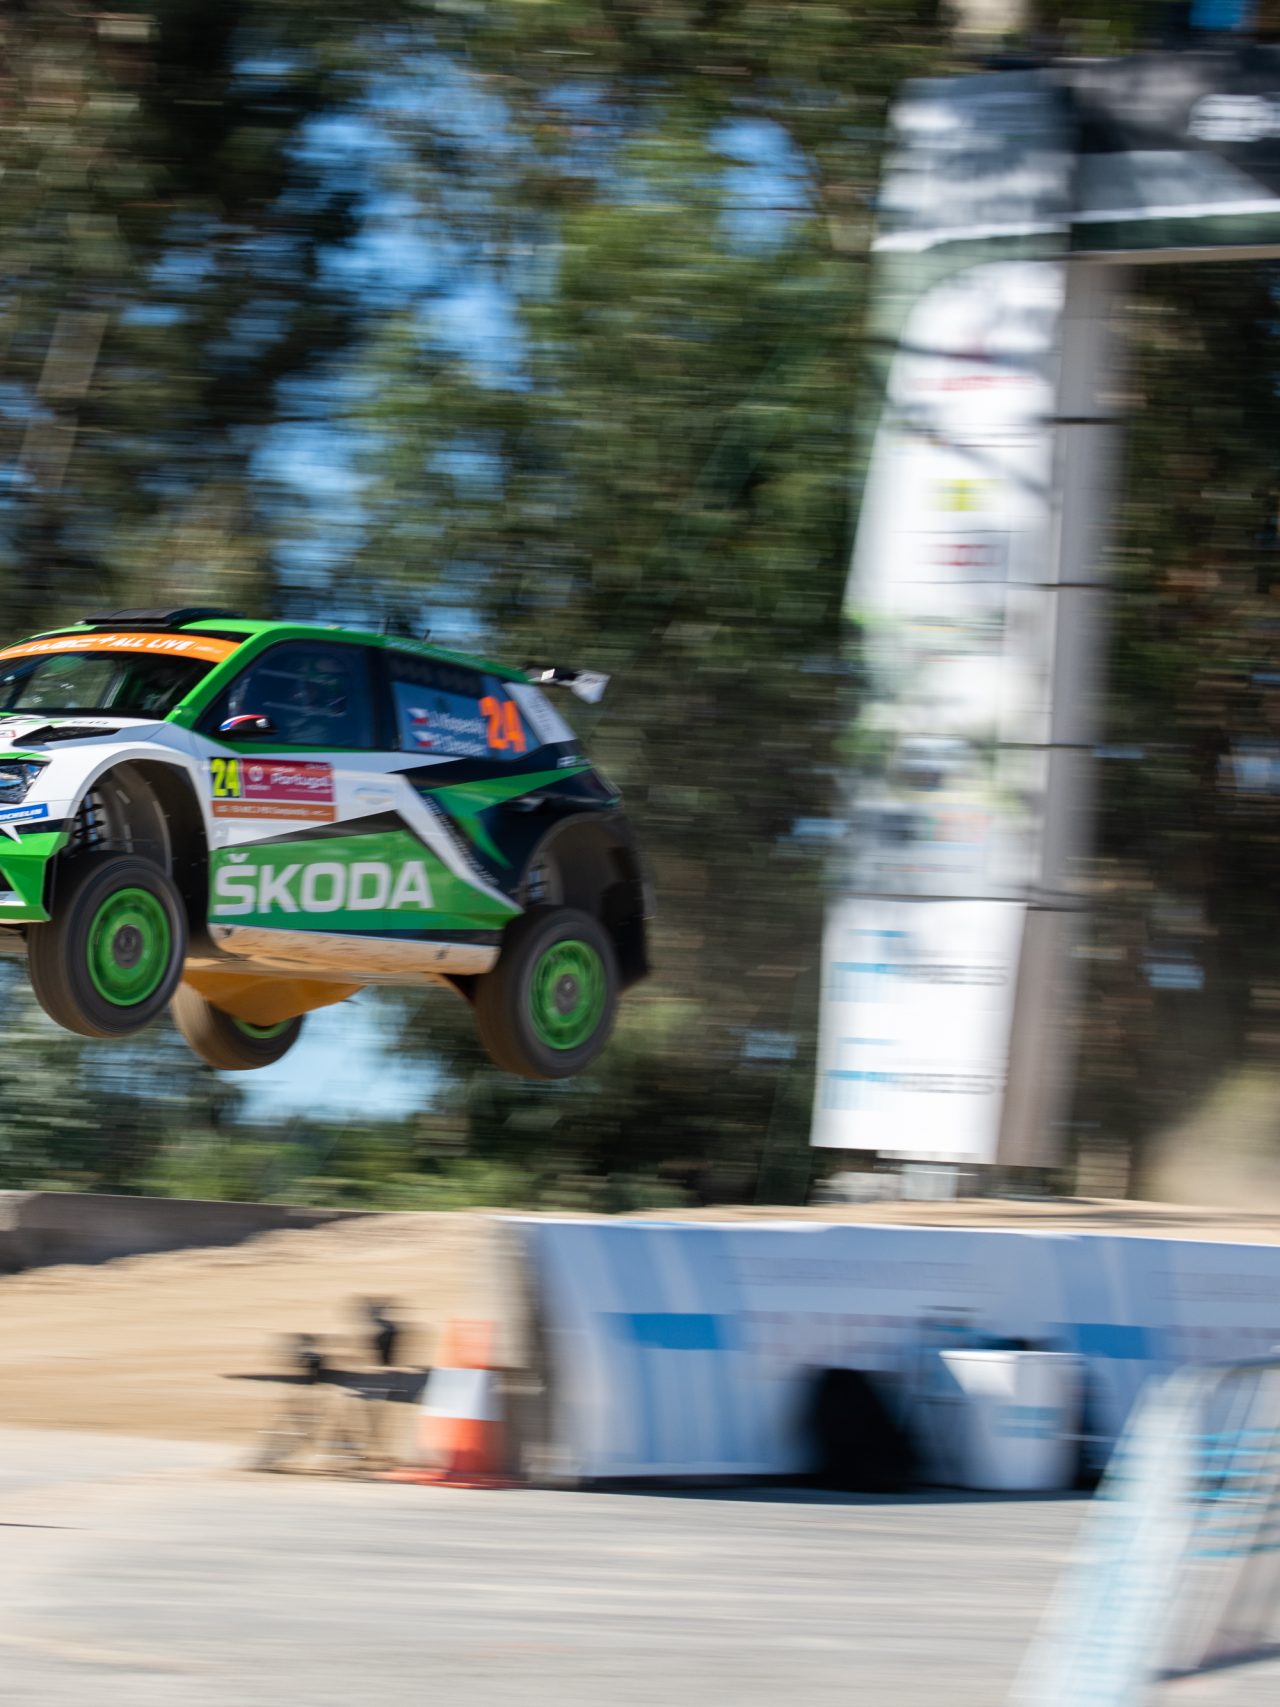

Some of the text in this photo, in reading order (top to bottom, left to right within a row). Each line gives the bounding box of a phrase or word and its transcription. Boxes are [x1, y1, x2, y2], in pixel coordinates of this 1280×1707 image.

[111, 636, 143, 648] ALL
[149, 640, 196, 651] LIVE
[479, 695, 527, 752] 24
[210, 758, 241, 797] 24
[213, 852, 435, 916] ŠKODA
